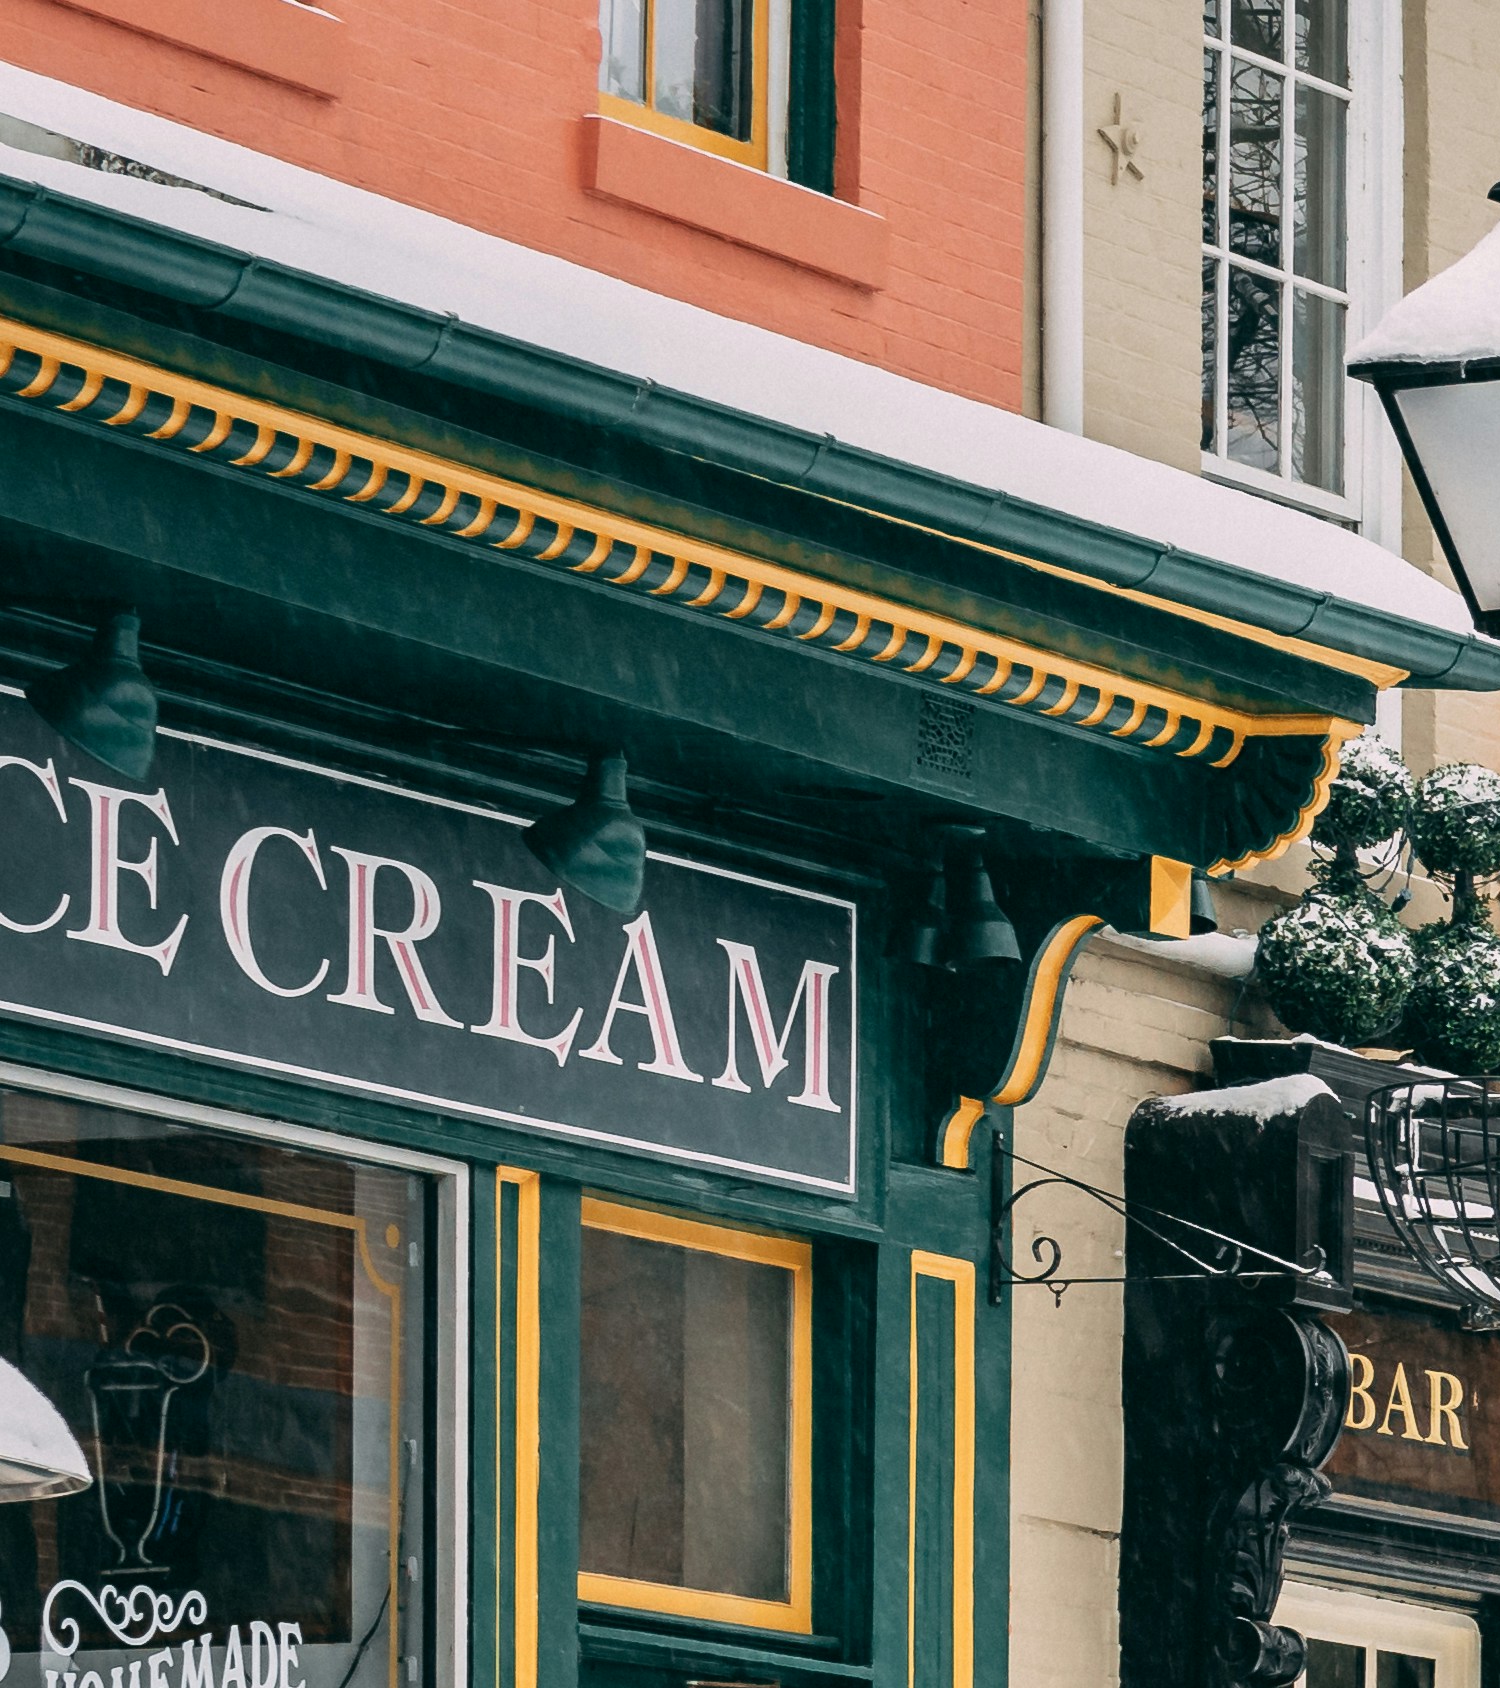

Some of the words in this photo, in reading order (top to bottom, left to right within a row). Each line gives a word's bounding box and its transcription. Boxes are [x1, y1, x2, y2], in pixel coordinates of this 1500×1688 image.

[0, 753, 190, 977] CE
[219, 824, 842, 1115] CREAM
[1346, 1352, 1470, 1451] BAR
